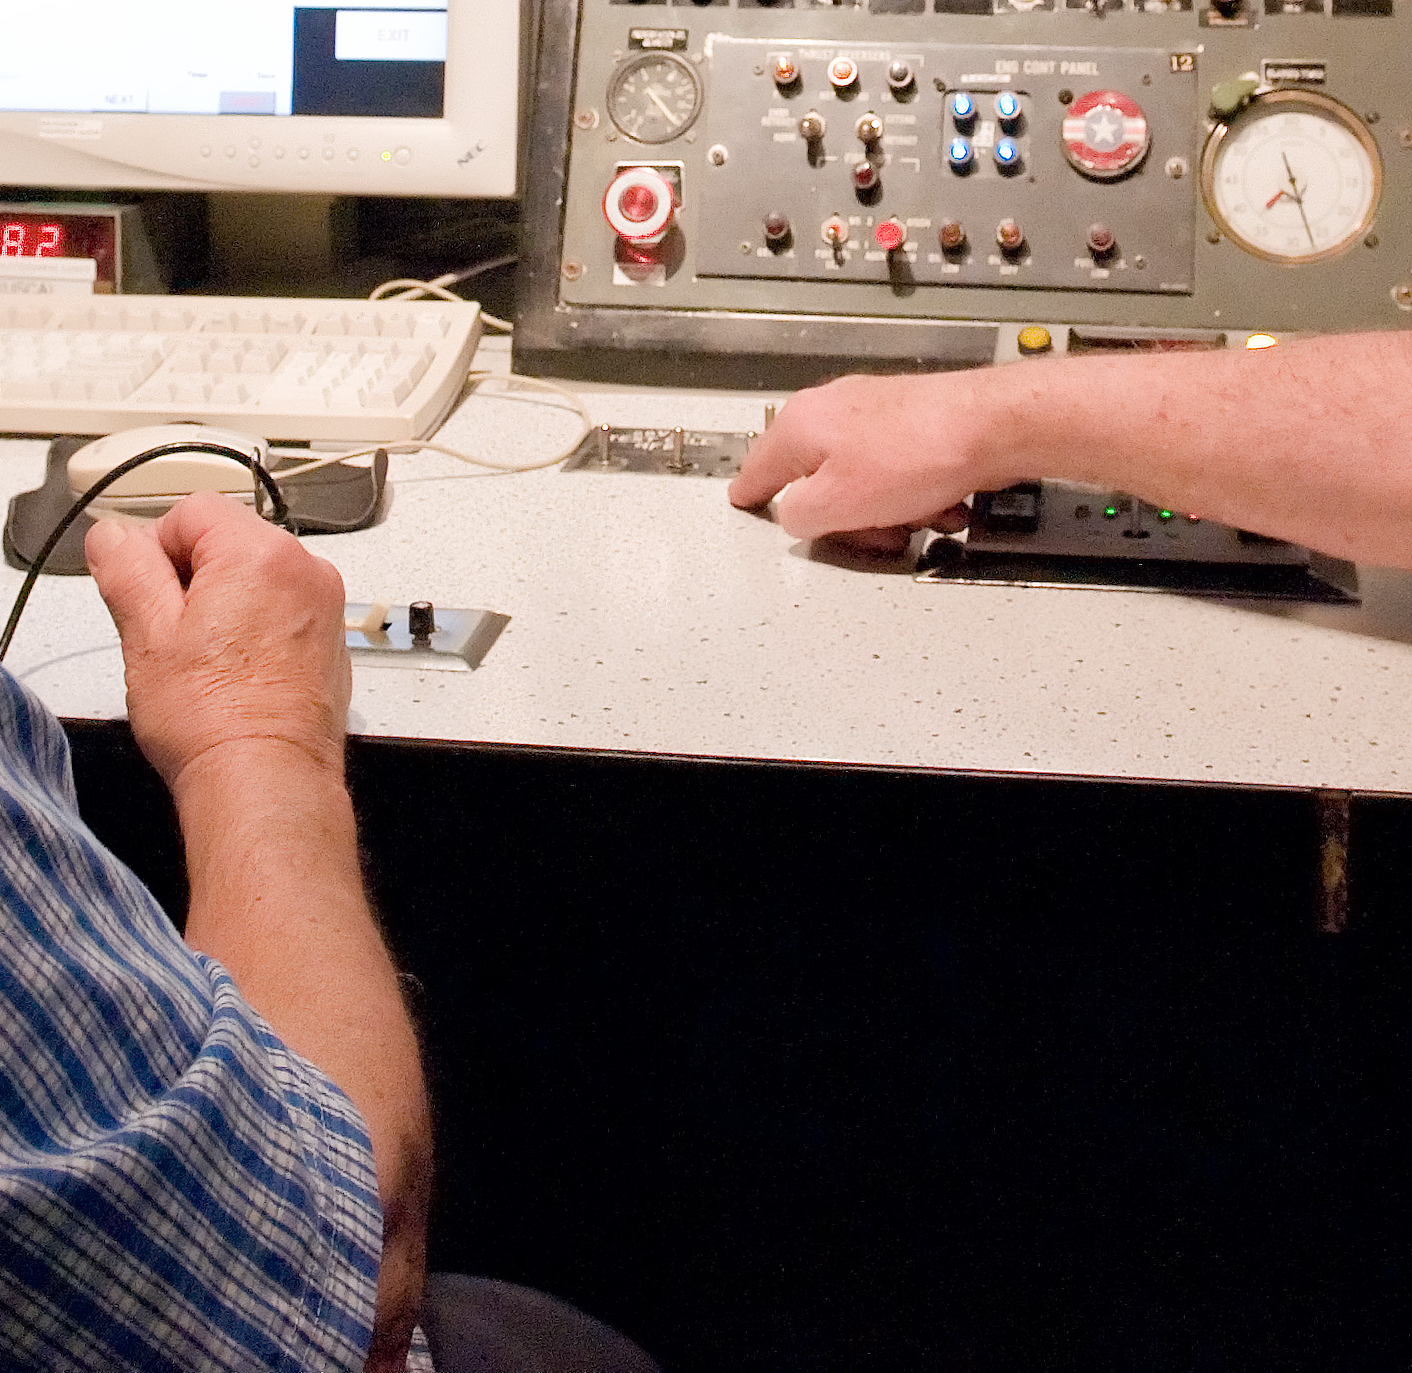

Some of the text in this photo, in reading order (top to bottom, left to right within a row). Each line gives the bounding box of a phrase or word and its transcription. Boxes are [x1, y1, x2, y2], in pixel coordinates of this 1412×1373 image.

[377, 29, 410, 42] EXIT
[1023, 60, 1054, 75] CONT
[1061, 60, 1099, 76] PANEL
[1171, 56, 1194, 71] 12
[457, 140, 485, 166] NEC
[0, 223, 63, 258] 82
